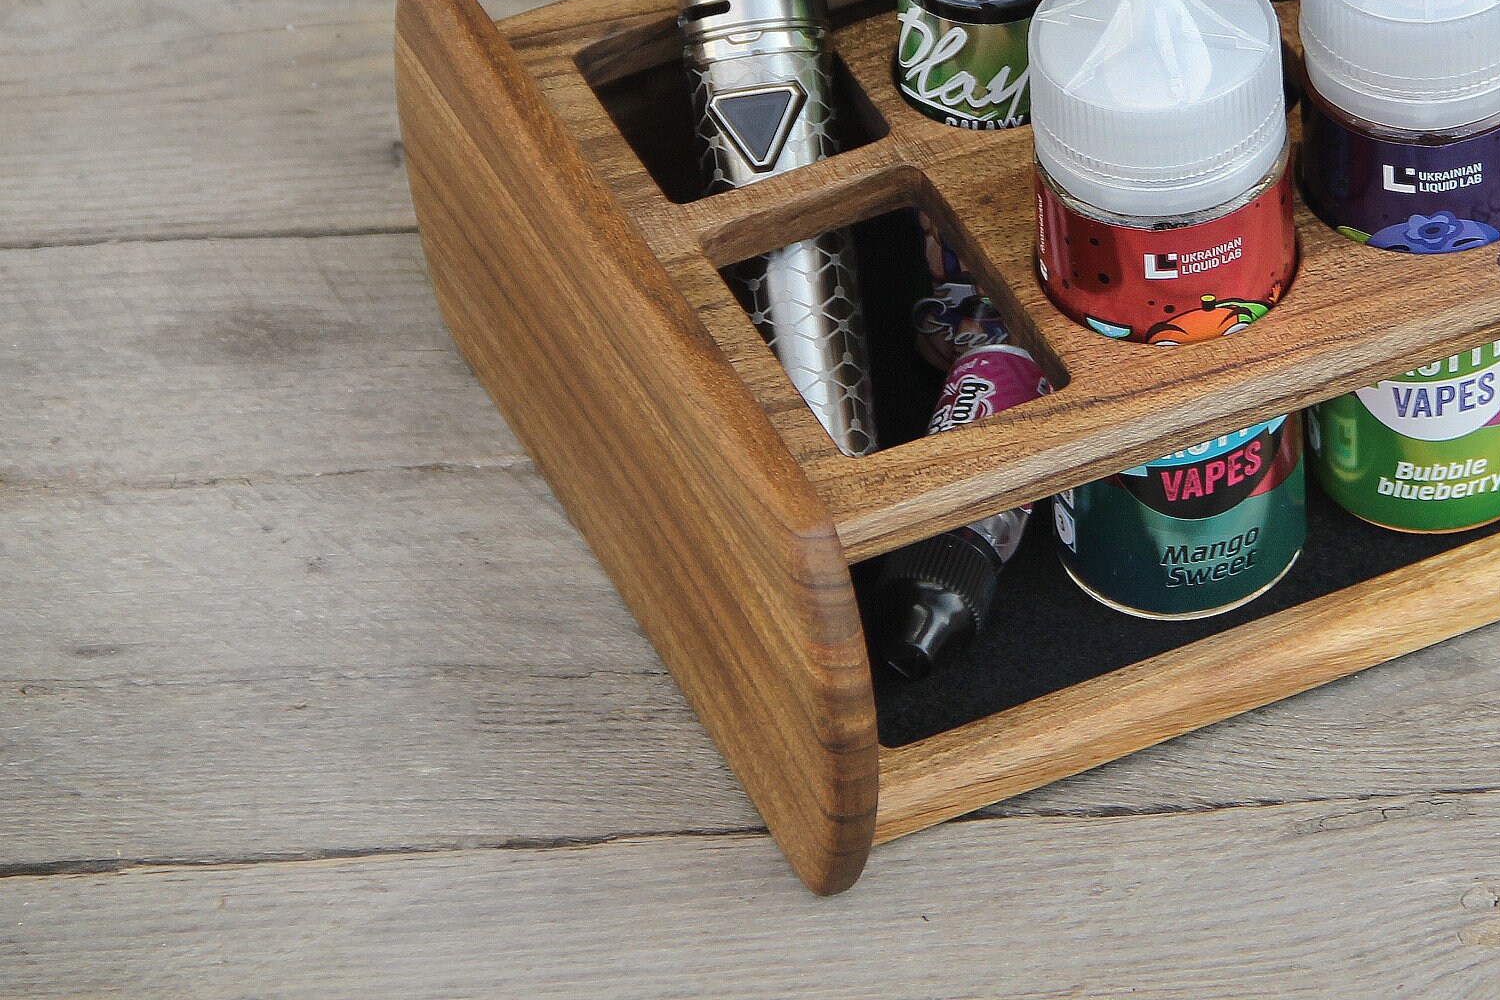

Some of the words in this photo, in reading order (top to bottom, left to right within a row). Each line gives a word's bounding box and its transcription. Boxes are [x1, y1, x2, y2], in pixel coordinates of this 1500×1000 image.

[1418, 162, 1482, 182] UKRAINIAN
[1419, 181, 1458, 194] LIQUID
[1460, 173, 1482, 188] LAB
[1181, 236, 1242, 264] UKRAINIAN
[1181, 256, 1220, 275] LIQUID
[1221, 248, 1242, 265] LAB
[1392, 372, 1496, 418] VAPES
[1160, 441, 1262, 502] VAPES
[1394, 458, 1488, 482] Bubble
[1159, 526, 1261, 567] Mango
[1165, 550, 1257, 588] Sweet
